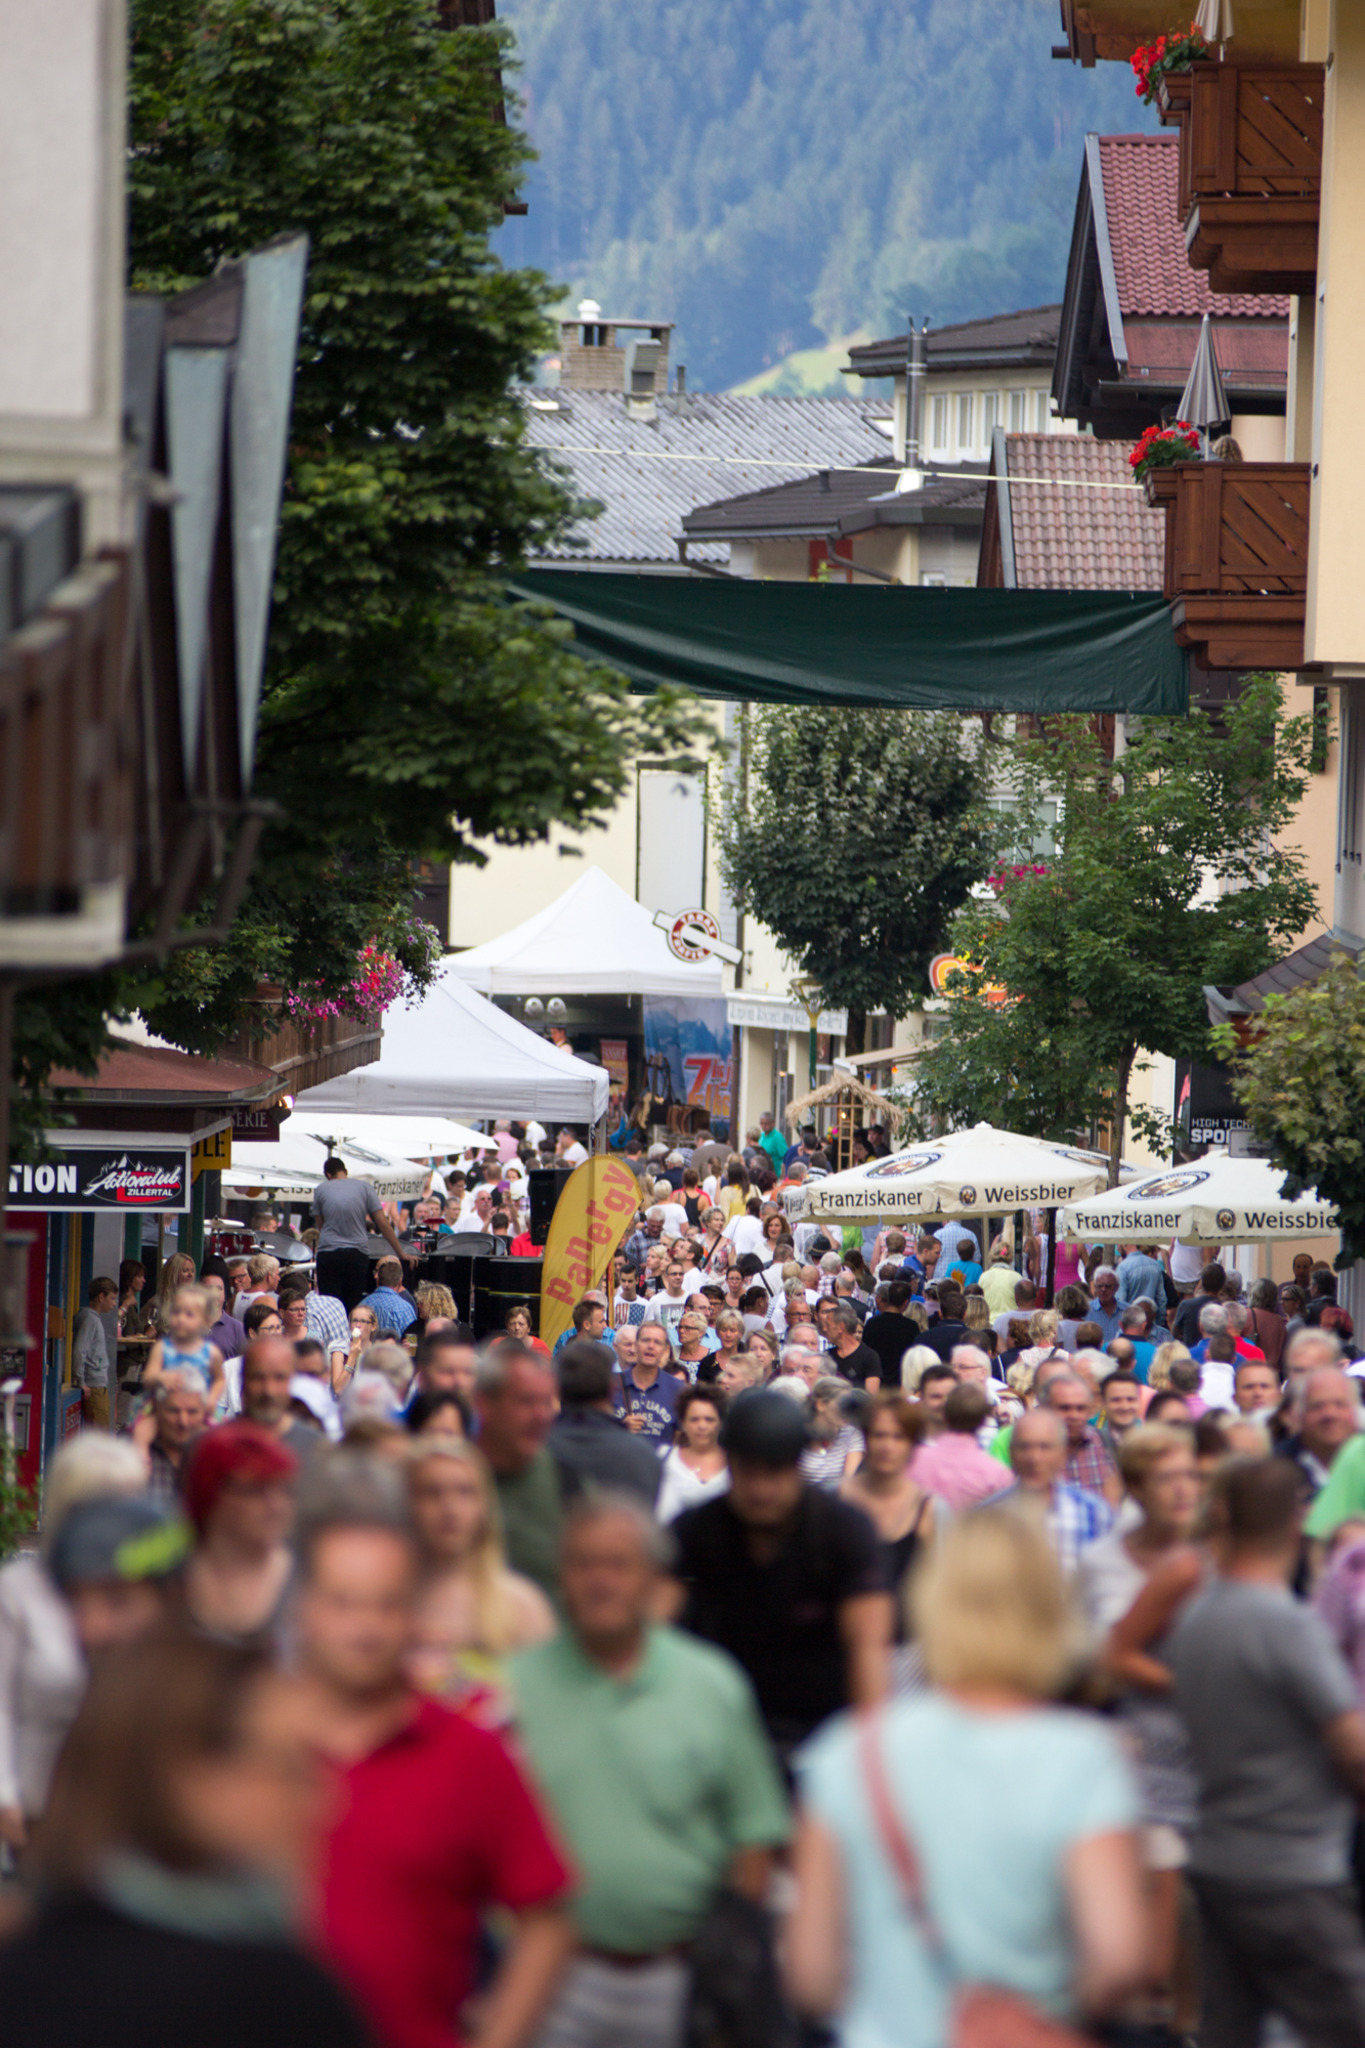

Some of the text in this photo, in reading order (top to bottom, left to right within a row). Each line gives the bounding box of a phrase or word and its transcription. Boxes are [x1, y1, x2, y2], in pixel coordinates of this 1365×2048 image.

[1192, 1119, 1219, 1128] HIGH
[126, 1187, 173, 1197] ZILLERTAL
[373, 1178, 423, 1196] Franziskaner
[984, 1183, 1076, 1203] Weissbier
[819, 1189, 923, 1208] Franziskaner
[1075, 1211, 1182, 1229] Franziskaner
[1244, 1211, 1338, 1229] Weissbie
